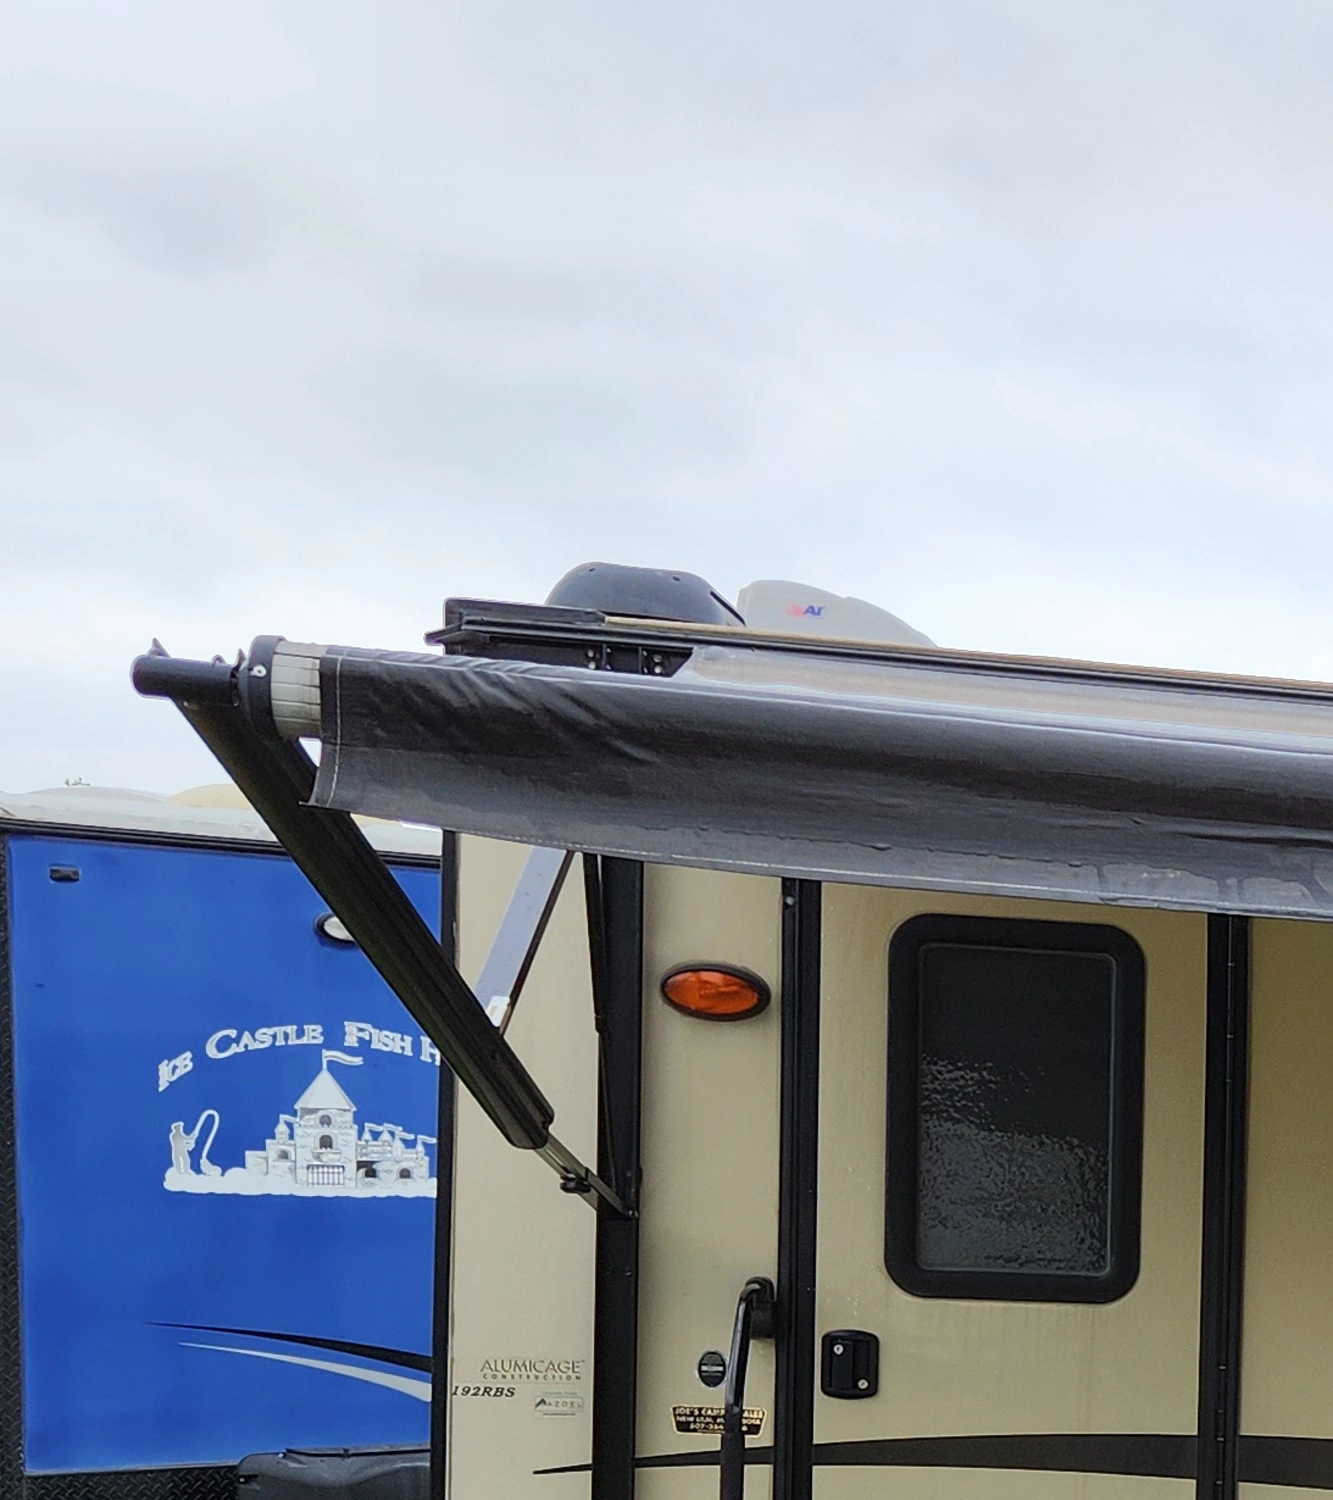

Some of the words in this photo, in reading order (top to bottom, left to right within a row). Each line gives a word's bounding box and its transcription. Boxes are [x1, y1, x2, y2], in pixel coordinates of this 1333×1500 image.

[158, 1051, 193, 1092] ICE
[206, 1025, 324, 1059] CASTLE
[344, 1021, 413, 1057] FISH
[481, 1359, 581, 1374] ALUMICAGE
[452, 1385, 516, 1398] 192RBS
